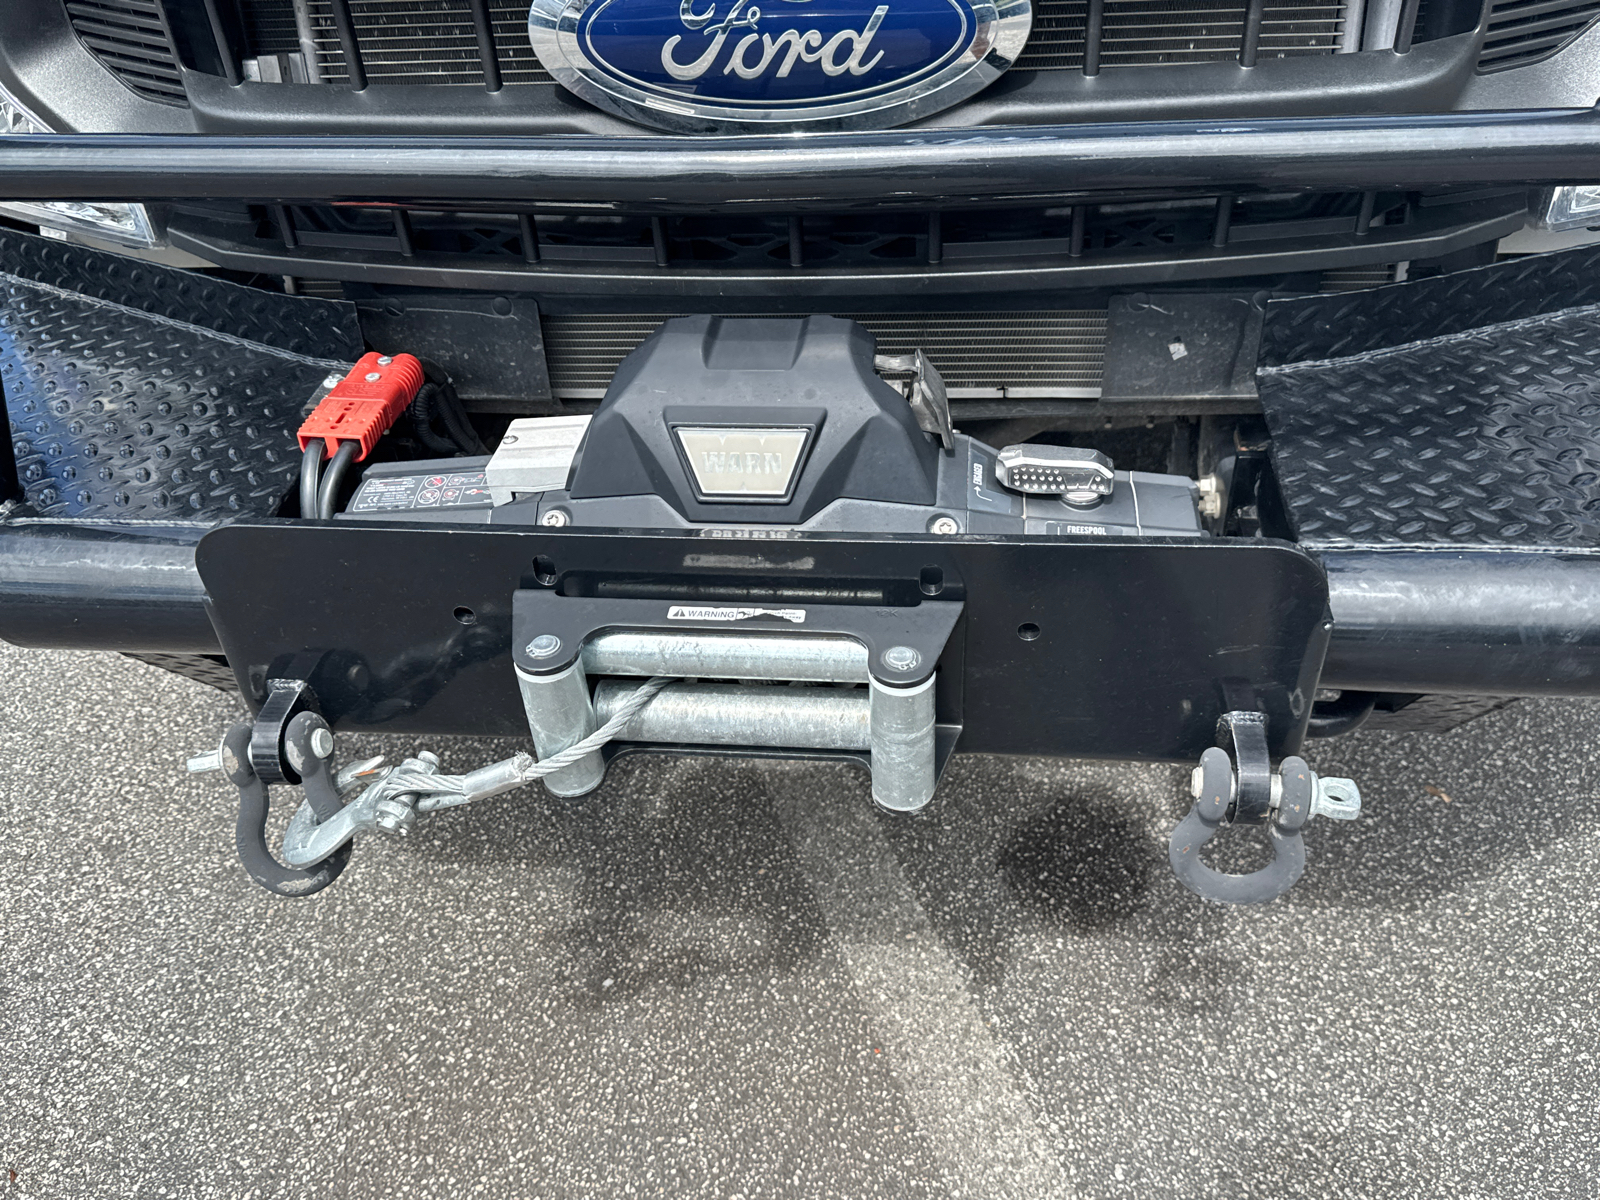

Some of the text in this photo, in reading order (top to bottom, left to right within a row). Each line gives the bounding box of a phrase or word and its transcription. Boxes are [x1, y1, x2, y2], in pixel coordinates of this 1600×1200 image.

[661, 0, 889, 80] Ford
[702, 452, 782, 475] WARN
[1067, 525, 1107, 535] FREESPOOL
[688, 610, 735, 618] WARNING
